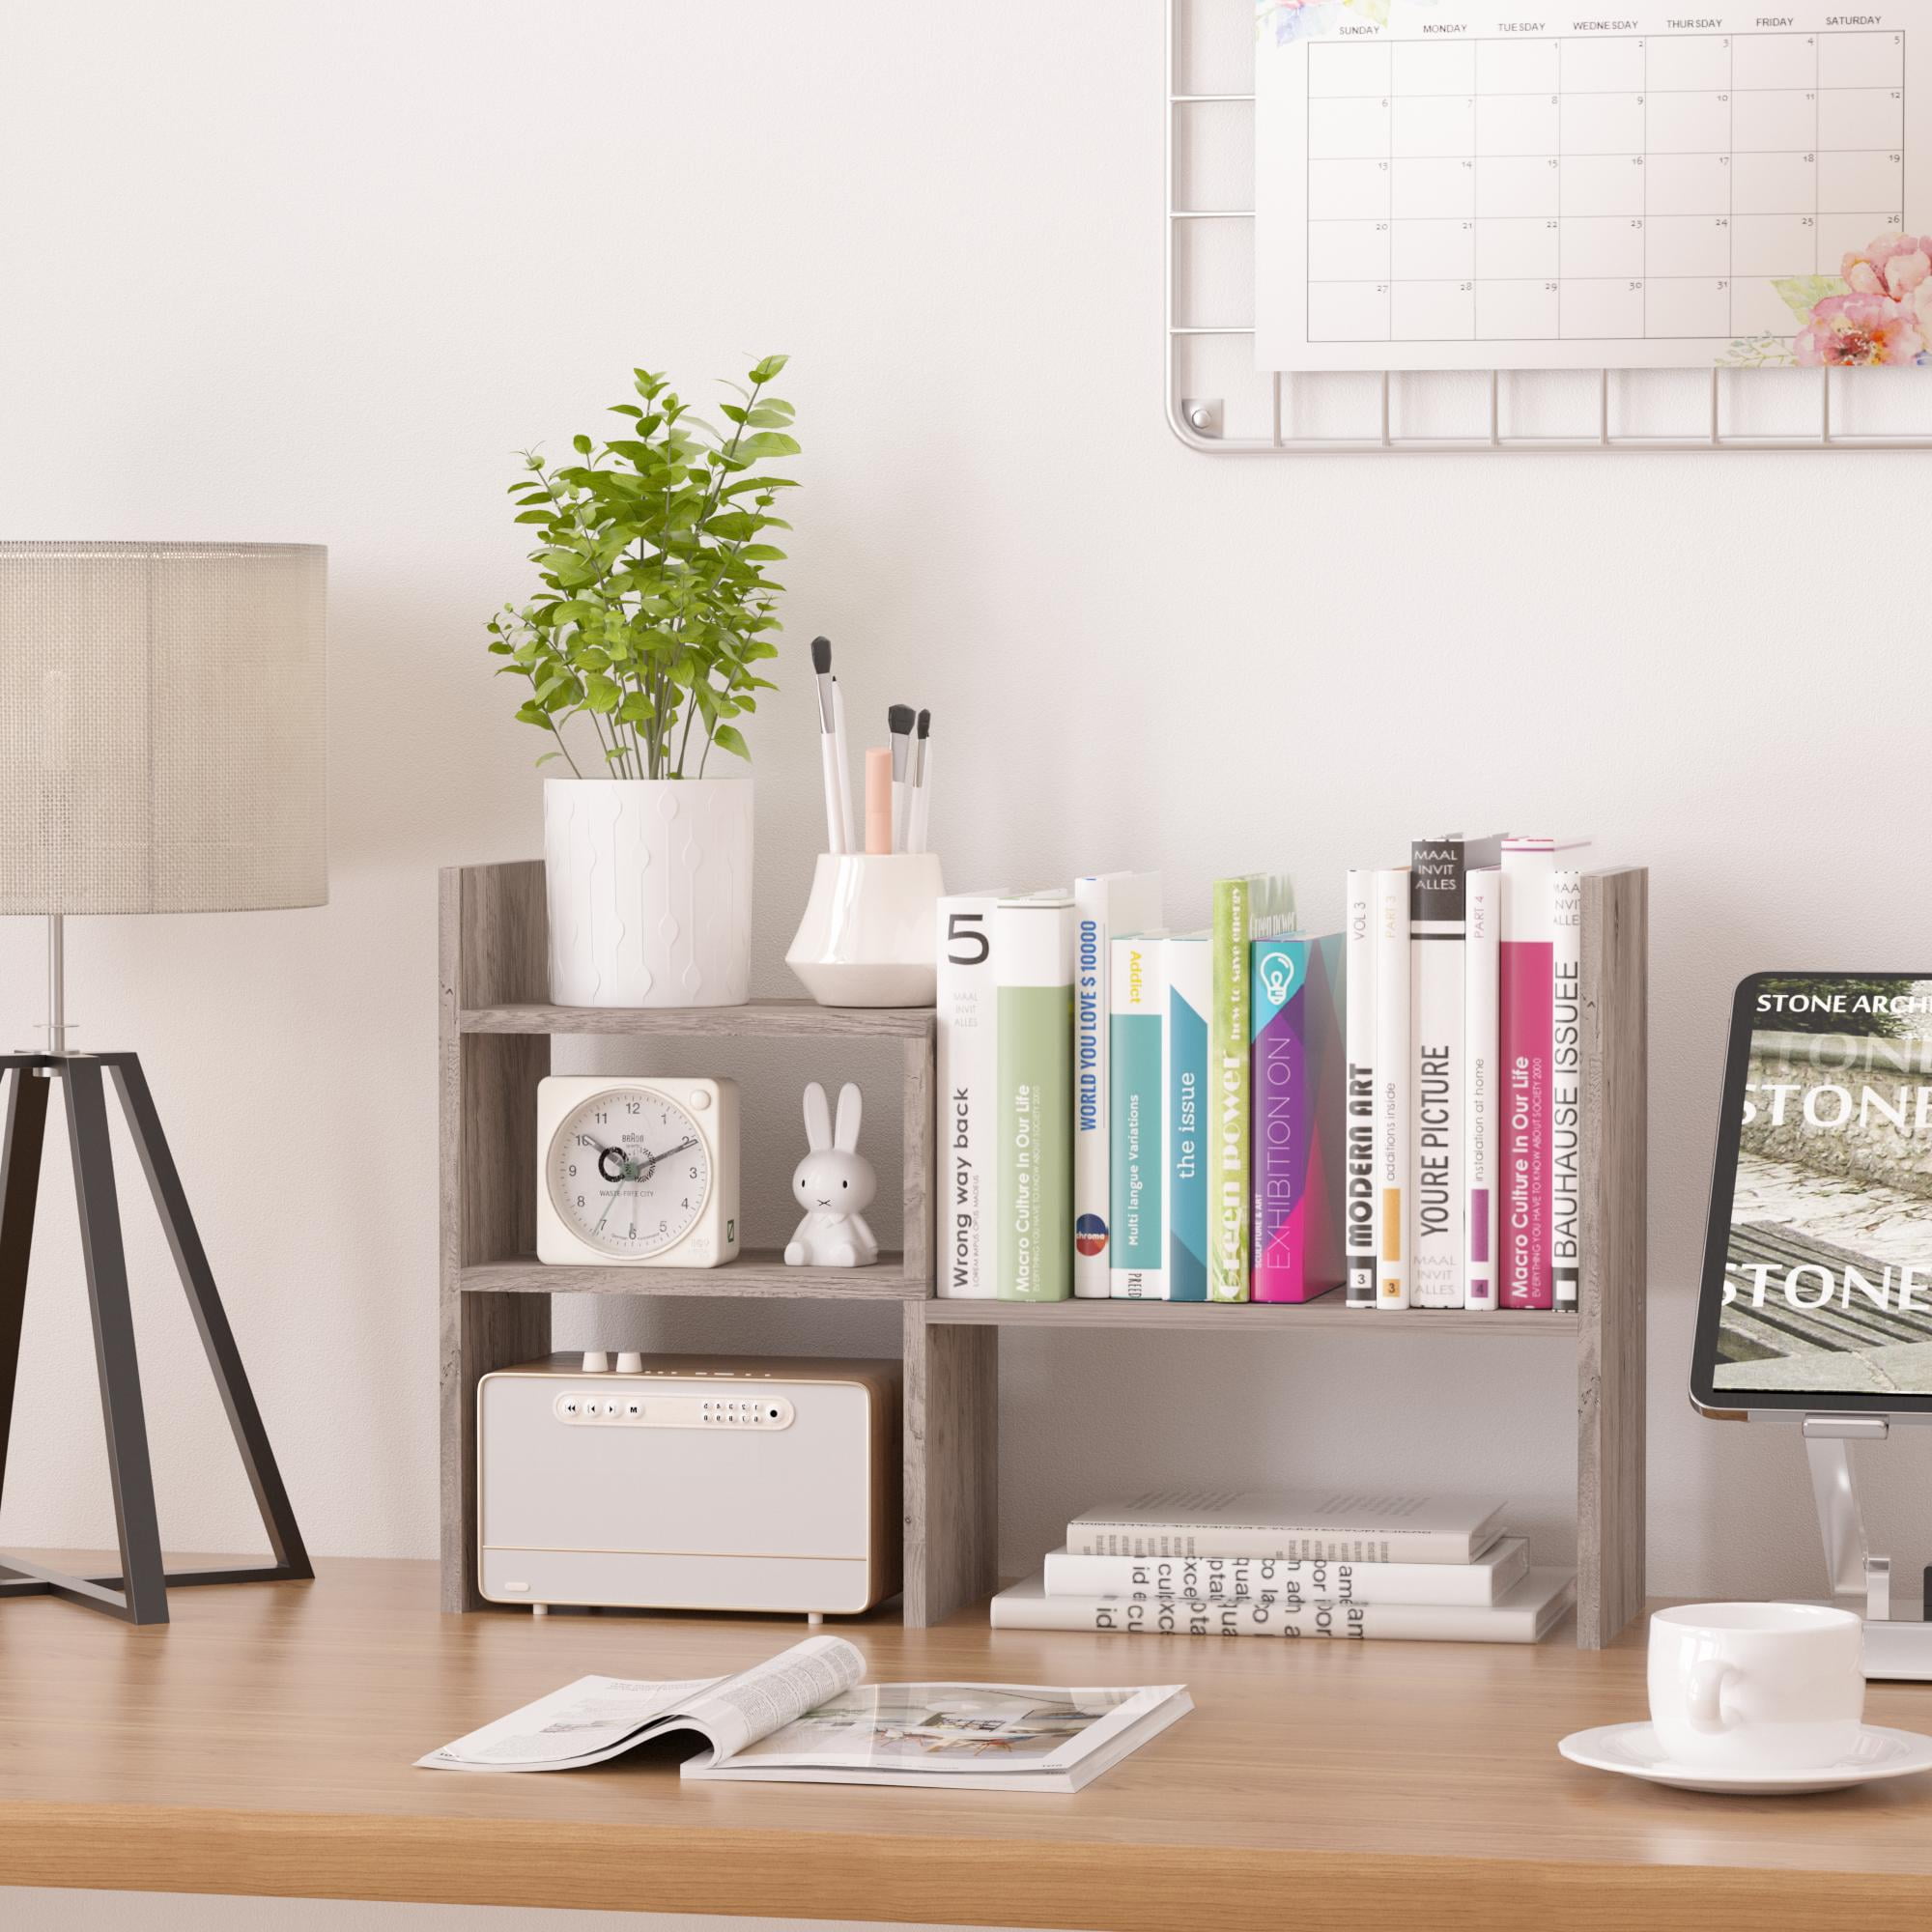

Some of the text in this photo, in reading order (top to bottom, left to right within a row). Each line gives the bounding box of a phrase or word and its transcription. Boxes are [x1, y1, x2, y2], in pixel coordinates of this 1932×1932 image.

[1340, 15, 1882, 35] SUNDAY MONDAY TUESDAY WEDNESDAY THURSDAY FRIDAY SATURDAY
[1414, 850, 1458, 860] MAAL
[1418, 865, 1455, 875] INVIT
[1415, 879, 1457, 890] ALLES
[1353, 913, 1366, 941] VOL
[1474, 908, 1485, 939] PART
[948, 914, 990, 966] 5
[1080, 921, 1096, 972] 10000
[1129, 950, 1143, 1005] Addict
[953, 993, 979, 1002] MAAL
[1756, 994, 1847, 1013] STONE
[955, 1005, 977, 1013] INVIT
[1080, 992, 1096, 1031] LOVE
[954, 1018, 979, 1028] ALLES
[1080, 1036, 1096, 1070] YOU
[626, 1103, 640, 1115] 12
[1080, 1074, 1096, 1131] WORLD
[1223, 1048, 1241, 1171] power
[1532, 1081, 1542, 1118] SOCIETY
[1554, 961, 1578, 1258] BAUHAUSE ISSUEE
[595, 1114, 608, 1124] 11
[661, 1114, 668, 1124] 1
[1178, 1072, 1195, 1179] the issue
[1474, 1059, 1485, 1182] instalation at home
[1385, 1083, 1396, 1181] additions inside
[1421, 1045, 1449, 1237] YOURE PICTURE
[1532, 1120, 1542, 1149] ABOUT
[1266, 1037, 1291, 1269] EXHIBITION ON
[1349, 1063, 1373, 1247] MODERN ART
[568, 1165, 577, 1177] 9
[690, 1167, 697, 1179] 3
[1127, 1094, 1143, 1246] Multi langue Variations
[1532, 1151, 1542, 1180] KNOW
[1511, 1056, 1529, 1298] Macro Culture In Our Life
[952, 1088, 973, 1288] Wrong way back
[1015, 1085, 1030, 1293] Macro Culture In Our Life
[1532, 1181, 1542, 1194] TO
[577, 1196, 585, 1208] 8
[681, 1198, 689, 1208] 4
[1254, 1193, 1263, 1210] ART
[1532, 1197, 1542, 1222] HAVE
[600, 1219, 608, 1231] 7
[629, 1229, 637, 1240] 6
[659, 1221, 668, 1233] 5
[1532, 1223, 1542, 1243] YOU
[1254, 1220, 1263, 1268] SCULPTURE
[1414, 1256, 1458, 1266] MAAL
[1357, 1274, 1366, 1285] 3
[1417, 1270, 1453, 1281] INVIT
[1388, 1283, 1396, 1293] 3
[1414, 1285, 1456, 1295] ALLES
[1476, 1284, 1484, 1294] 4
